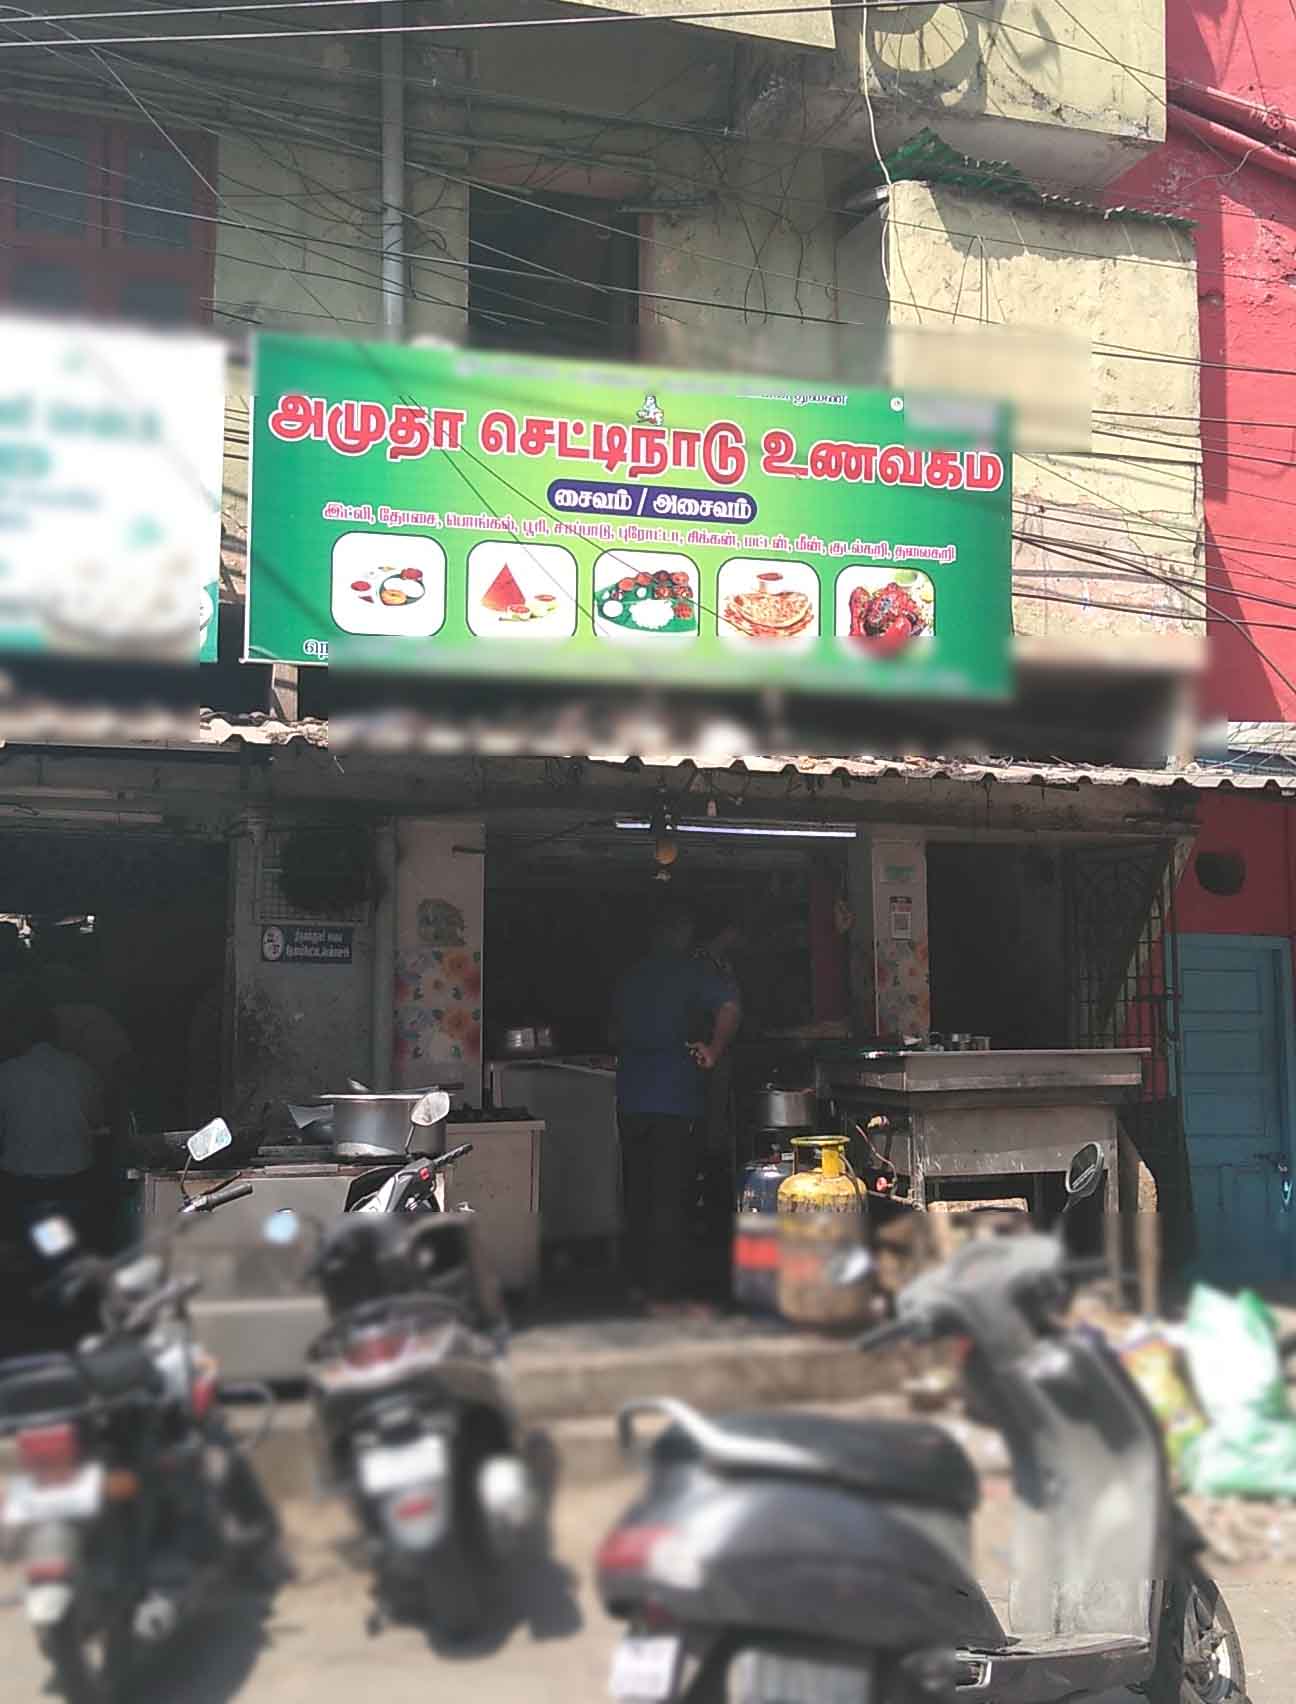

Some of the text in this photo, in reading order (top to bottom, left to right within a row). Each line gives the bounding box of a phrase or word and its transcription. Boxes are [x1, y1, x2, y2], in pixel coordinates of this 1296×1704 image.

[269, 394, 1003, 491] அமுதா செட்டிநாடு உணவகம
[554, 487, 632, 511] சைவம்
[652, 494, 752, 519] அசைவம்
